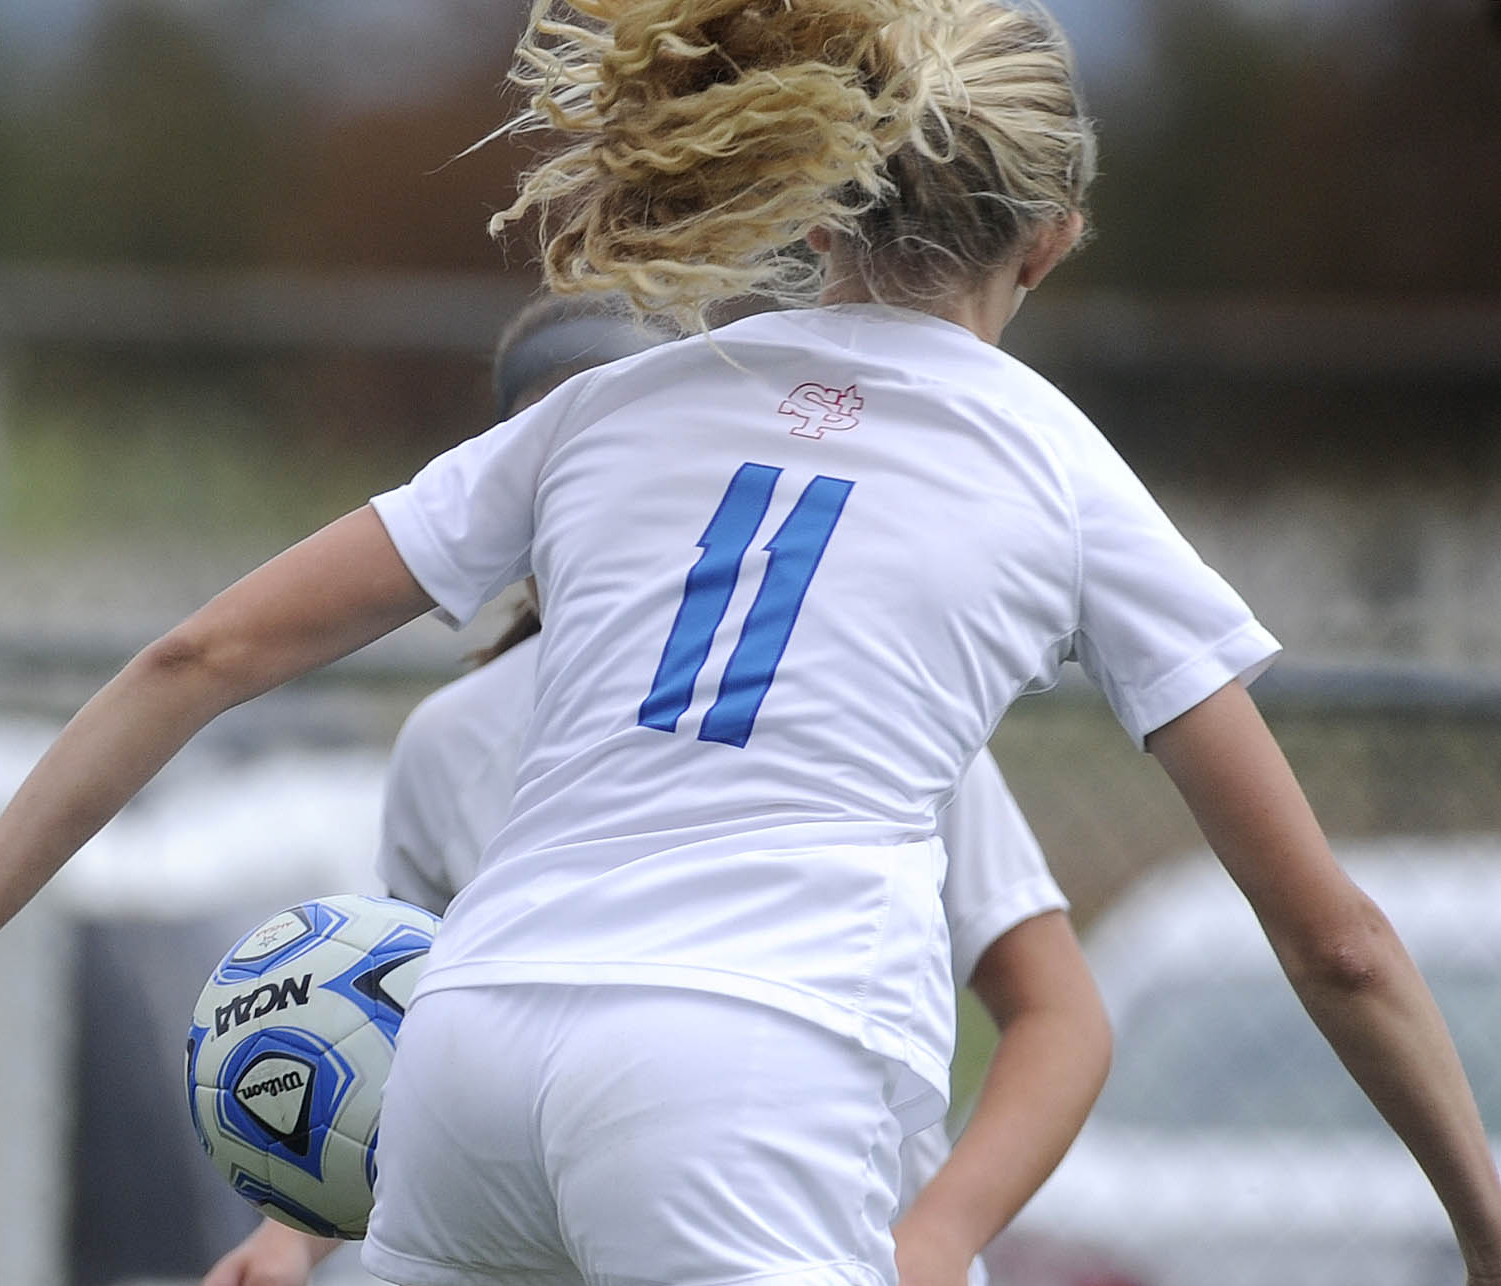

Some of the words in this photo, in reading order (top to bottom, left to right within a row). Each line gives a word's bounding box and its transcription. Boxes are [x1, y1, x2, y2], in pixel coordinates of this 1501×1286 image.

[637, 462, 856, 749] 11
[215, 973, 313, 1037] NCAA
[237, 1070, 305, 1100] Wilson
